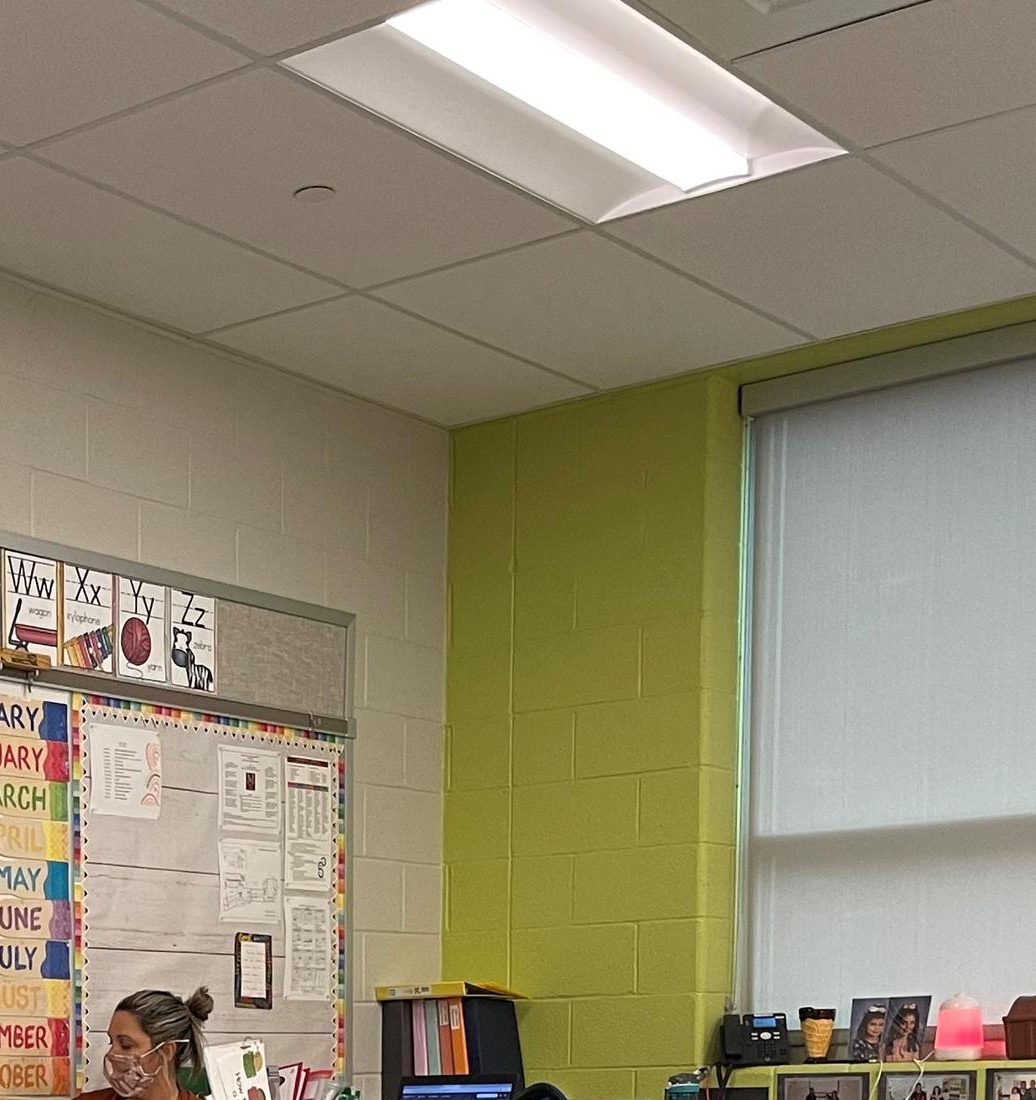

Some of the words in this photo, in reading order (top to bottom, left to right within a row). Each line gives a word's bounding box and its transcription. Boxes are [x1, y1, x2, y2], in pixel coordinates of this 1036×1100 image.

[8, 555, 54, 599] Ww
[75, 567, 101, 606] Xx
[28, 607, 52, 619] wagon
[130, 580, 154, 624] Yy
[181, 591, 206, 628] Zz
[66, 609, 101, 625] xylophone
[193, 640, 212, 651] zebra
[147, 663, 164, 673] yarn
